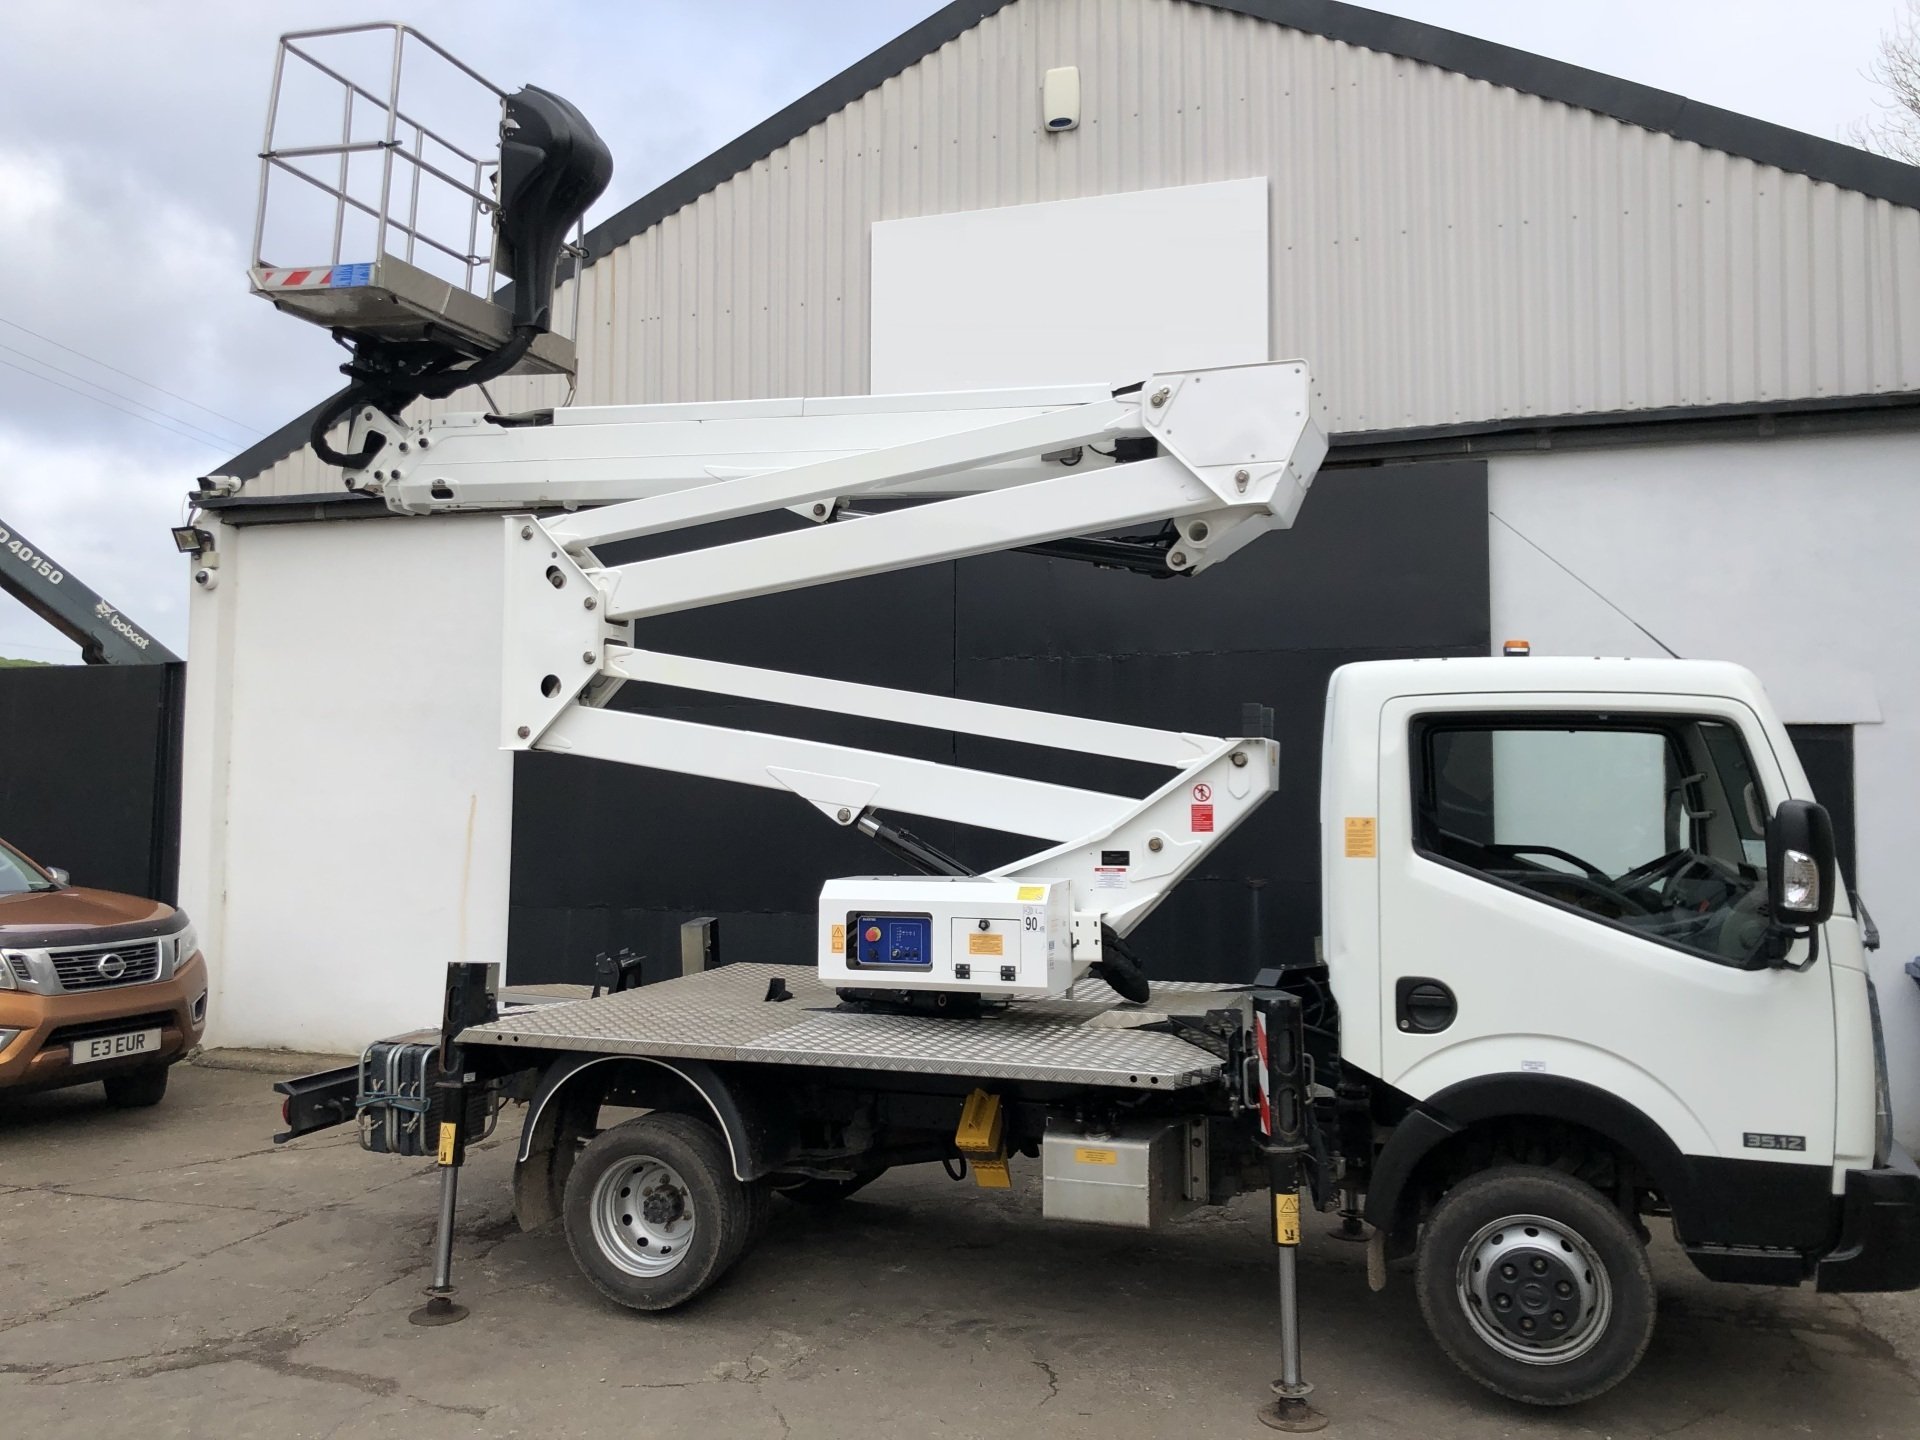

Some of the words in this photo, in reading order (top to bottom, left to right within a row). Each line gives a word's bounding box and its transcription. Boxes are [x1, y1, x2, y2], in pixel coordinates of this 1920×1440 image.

[8, 540, 64, 585] 40150
[111, 614, 150, 650] bobcat
[1025, 916, 1038, 931] 90
[91, 1039, 111, 1058] E3
[116, 1033, 145, 1054] EUR
[1746, 1134, 1802, 1150] 35.12
